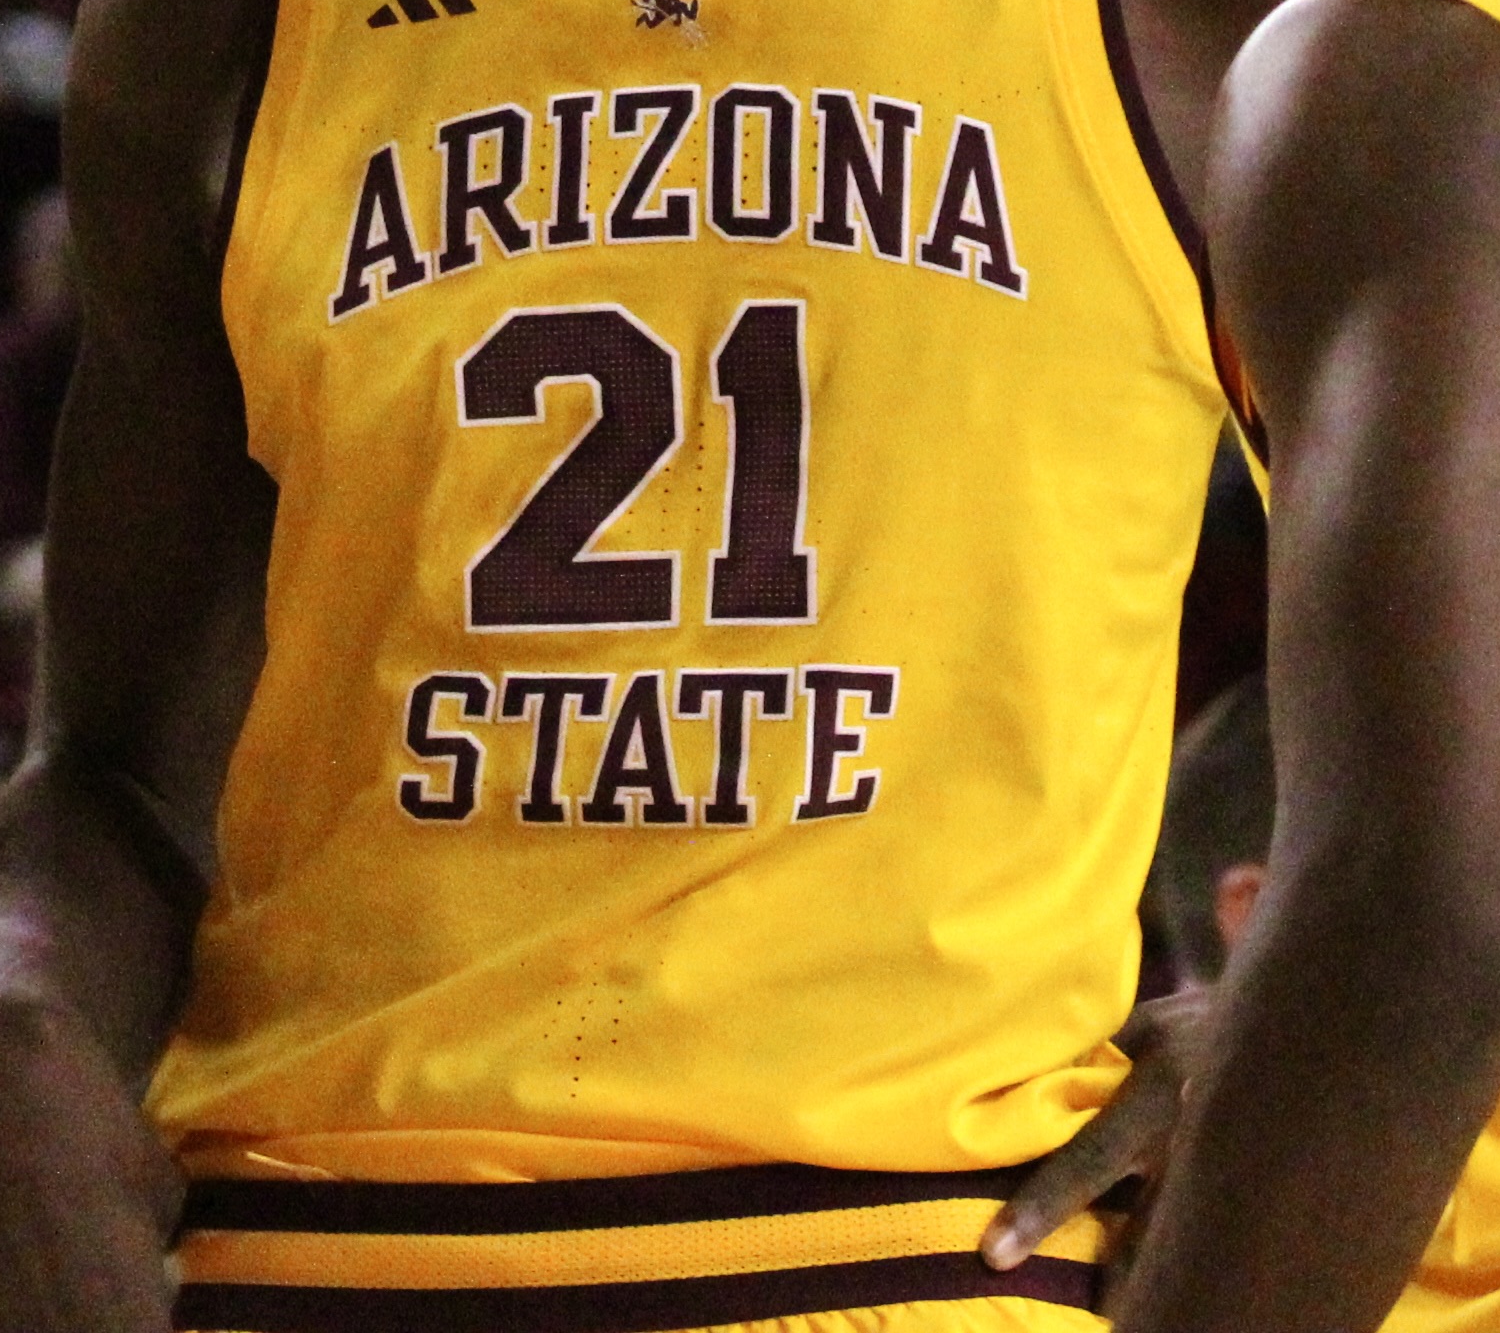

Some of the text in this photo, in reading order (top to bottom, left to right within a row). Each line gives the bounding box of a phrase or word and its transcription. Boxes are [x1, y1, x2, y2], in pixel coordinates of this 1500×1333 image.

[328, 84, 1029, 325] ARIZONA
[455, 300, 819, 633] 21
[398, 665, 901, 825] STATE
